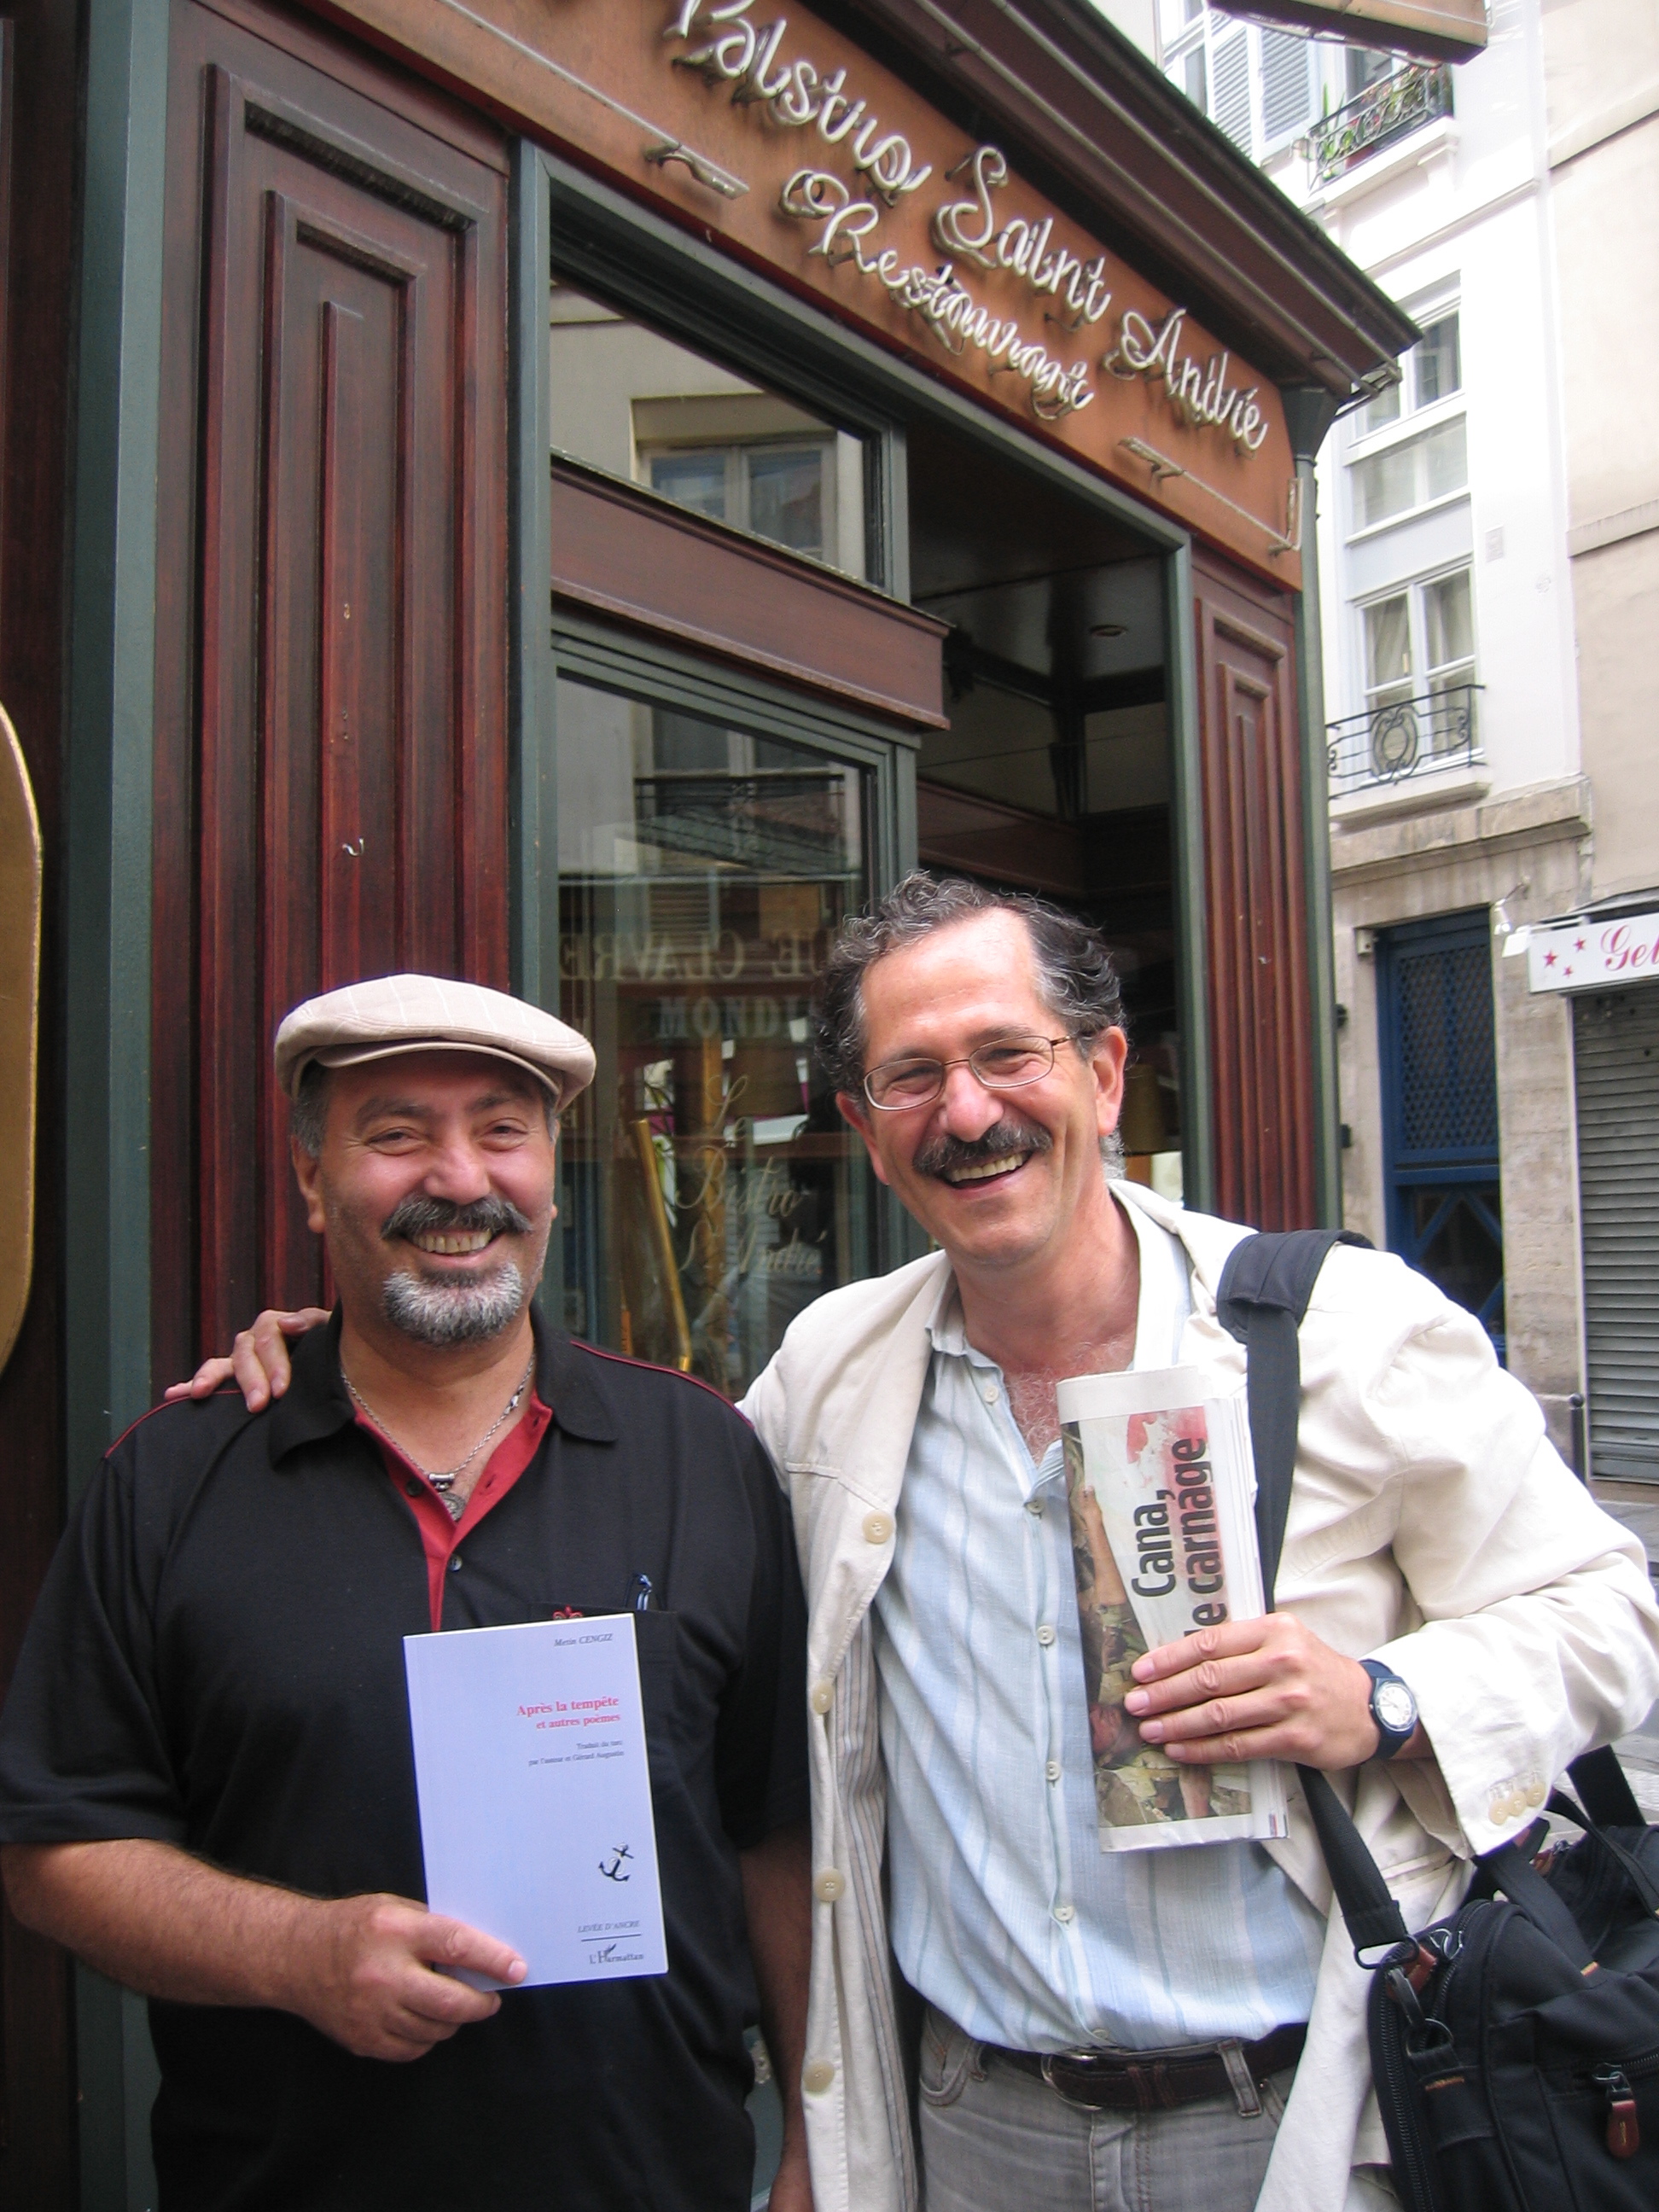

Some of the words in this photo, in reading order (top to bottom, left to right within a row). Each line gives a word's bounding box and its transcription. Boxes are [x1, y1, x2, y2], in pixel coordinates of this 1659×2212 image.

[780, 170, 1096, 422] Restaurant
[935, 146, 1111, 324] Saint
[1118, 306, 1269, 452] André
[1132, 1489, 1176, 1598] Cana,
[1172, 1437, 1224, 1594] carnage
[579, 1633, 613, 1644] CENGIZ
[517, 1703, 553, 1717] Après
[556, 1701, 568, 1712] la
[571, 1696, 620, 1710] tempête
[536, 1720, 546, 1729] et
[549, 1718, 580, 1728] autres
